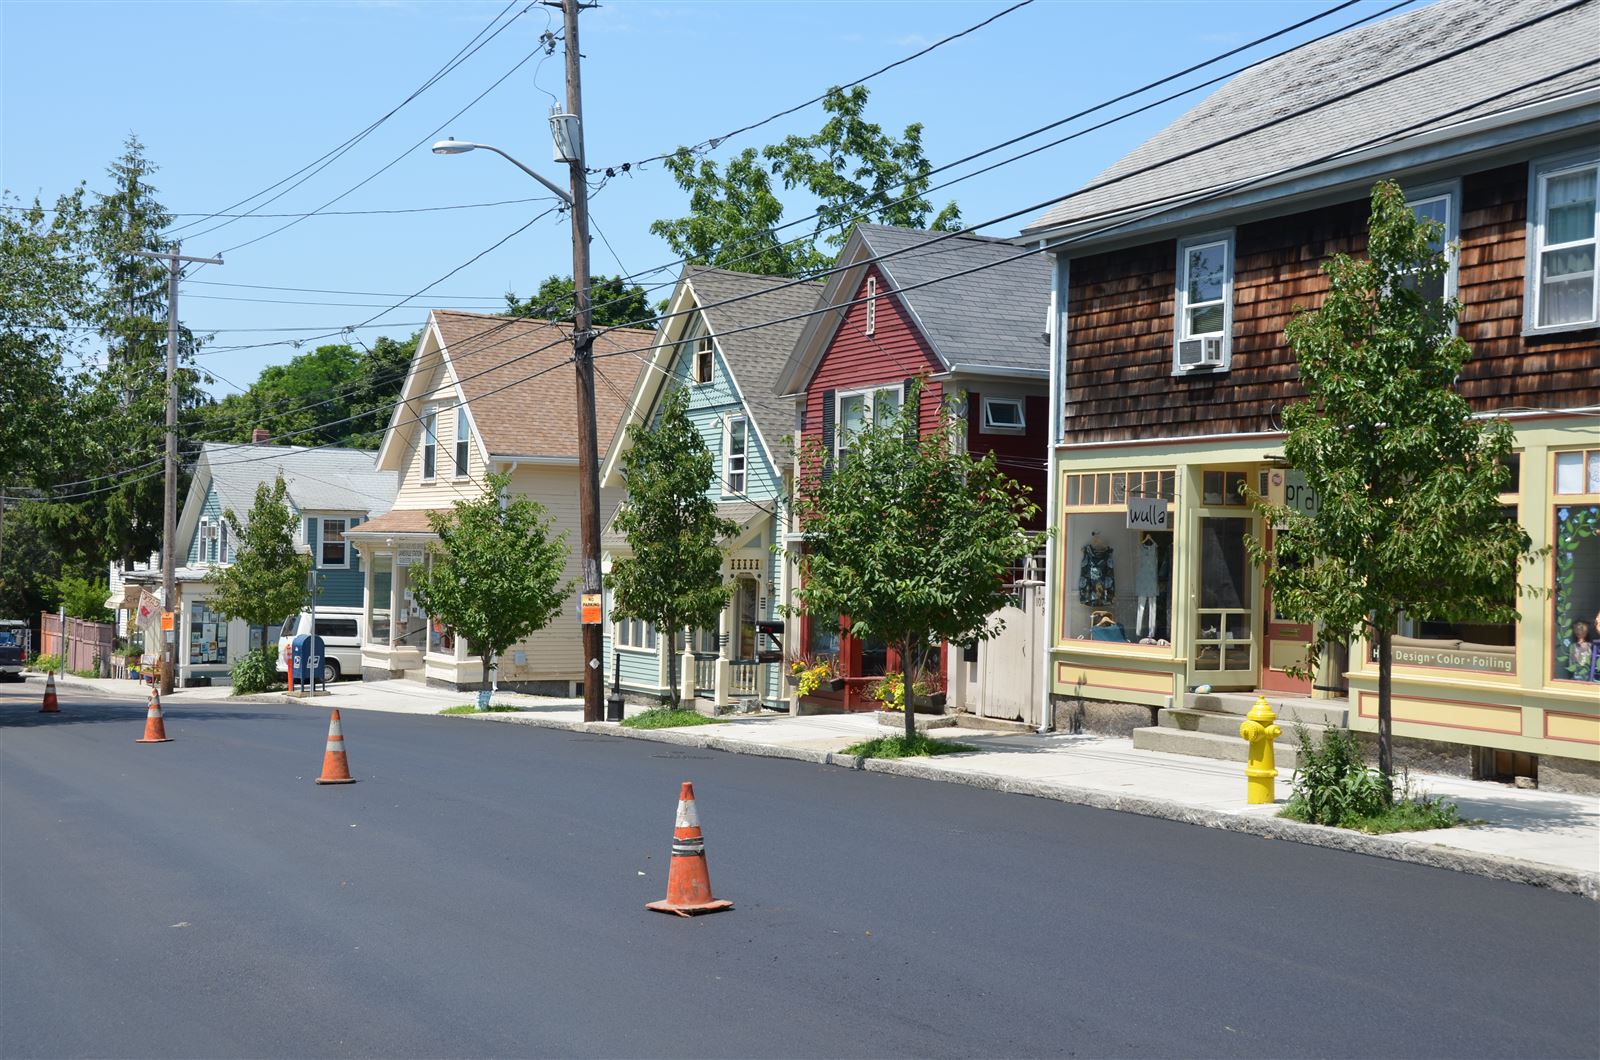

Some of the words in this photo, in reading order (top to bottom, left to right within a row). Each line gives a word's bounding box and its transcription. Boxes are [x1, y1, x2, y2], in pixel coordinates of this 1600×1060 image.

[1130, 505, 1165, 525] wulla
[1395, 650, 1430, 664] Design
[1436, 653, 1465, 665] Color
[1472, 656, 1512, 672] Foiling
